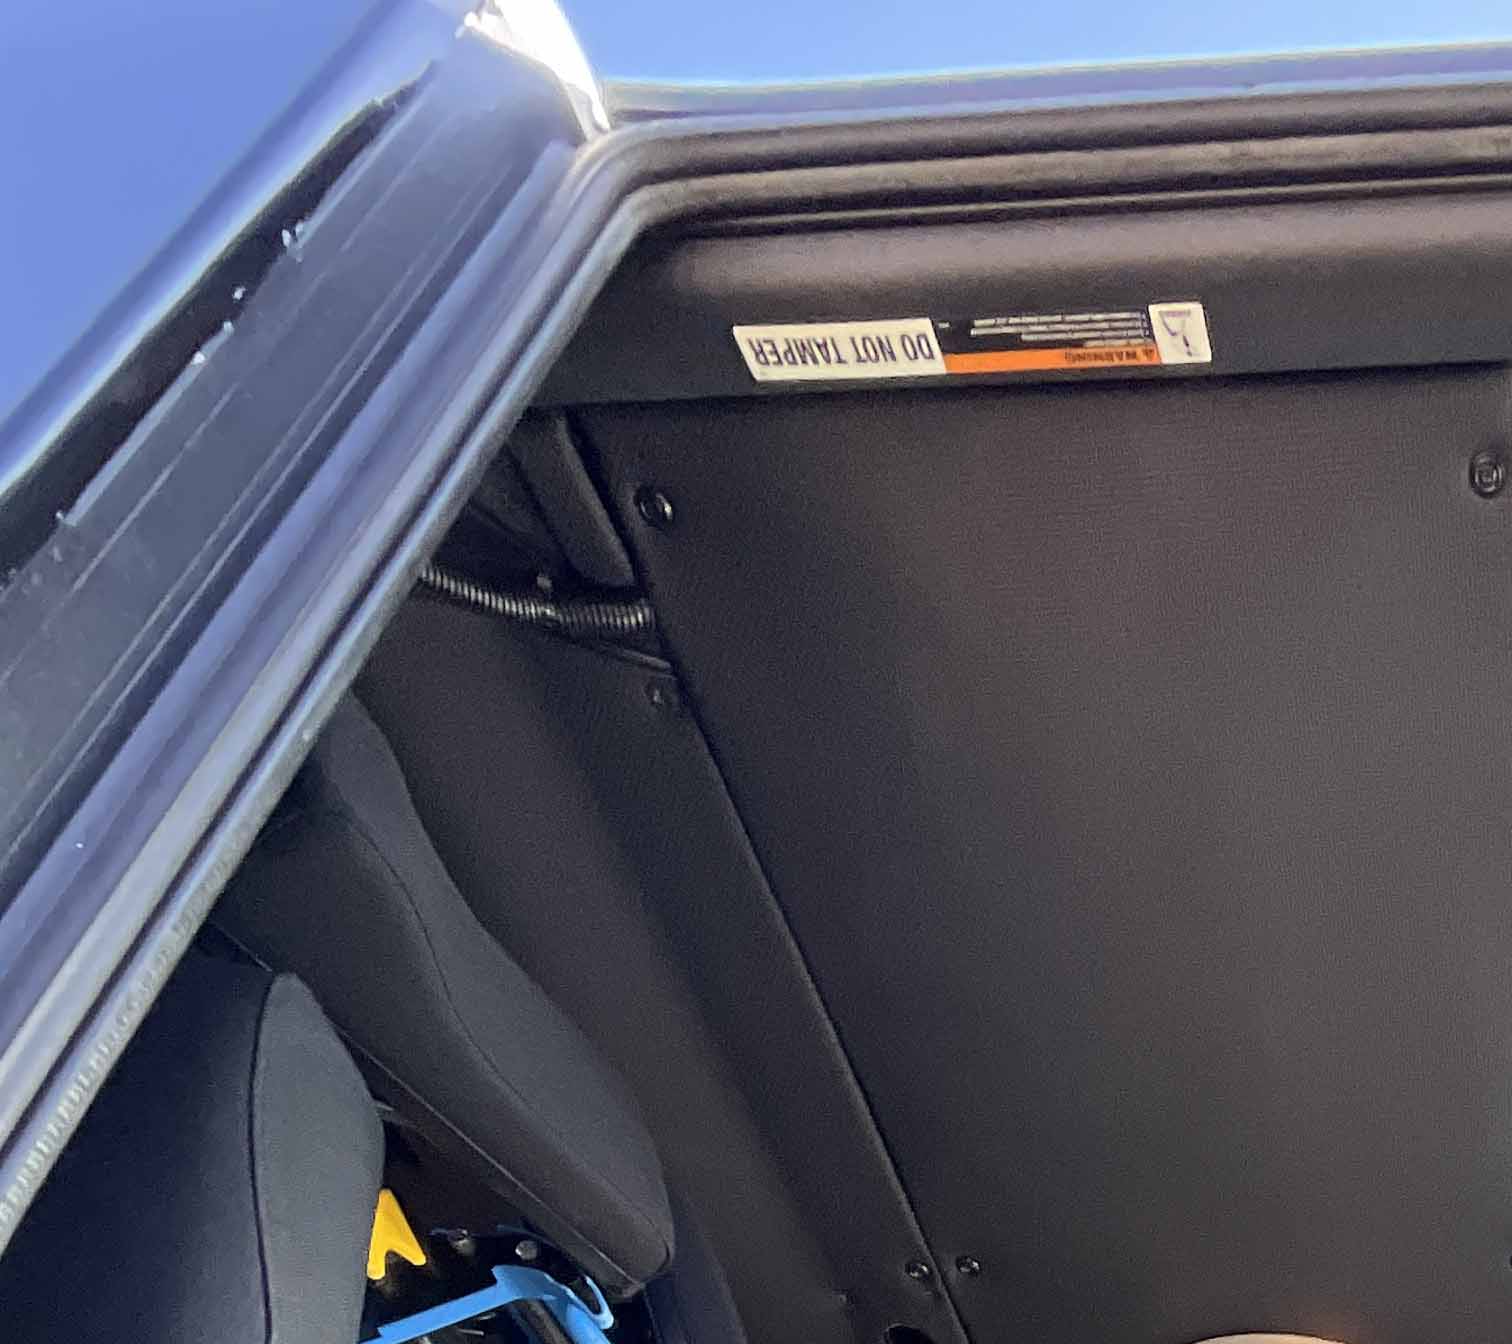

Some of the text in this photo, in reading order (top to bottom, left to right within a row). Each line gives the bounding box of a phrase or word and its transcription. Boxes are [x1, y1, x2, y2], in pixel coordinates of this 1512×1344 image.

[747, 333, 936, 367] DO NOT TAMPER
